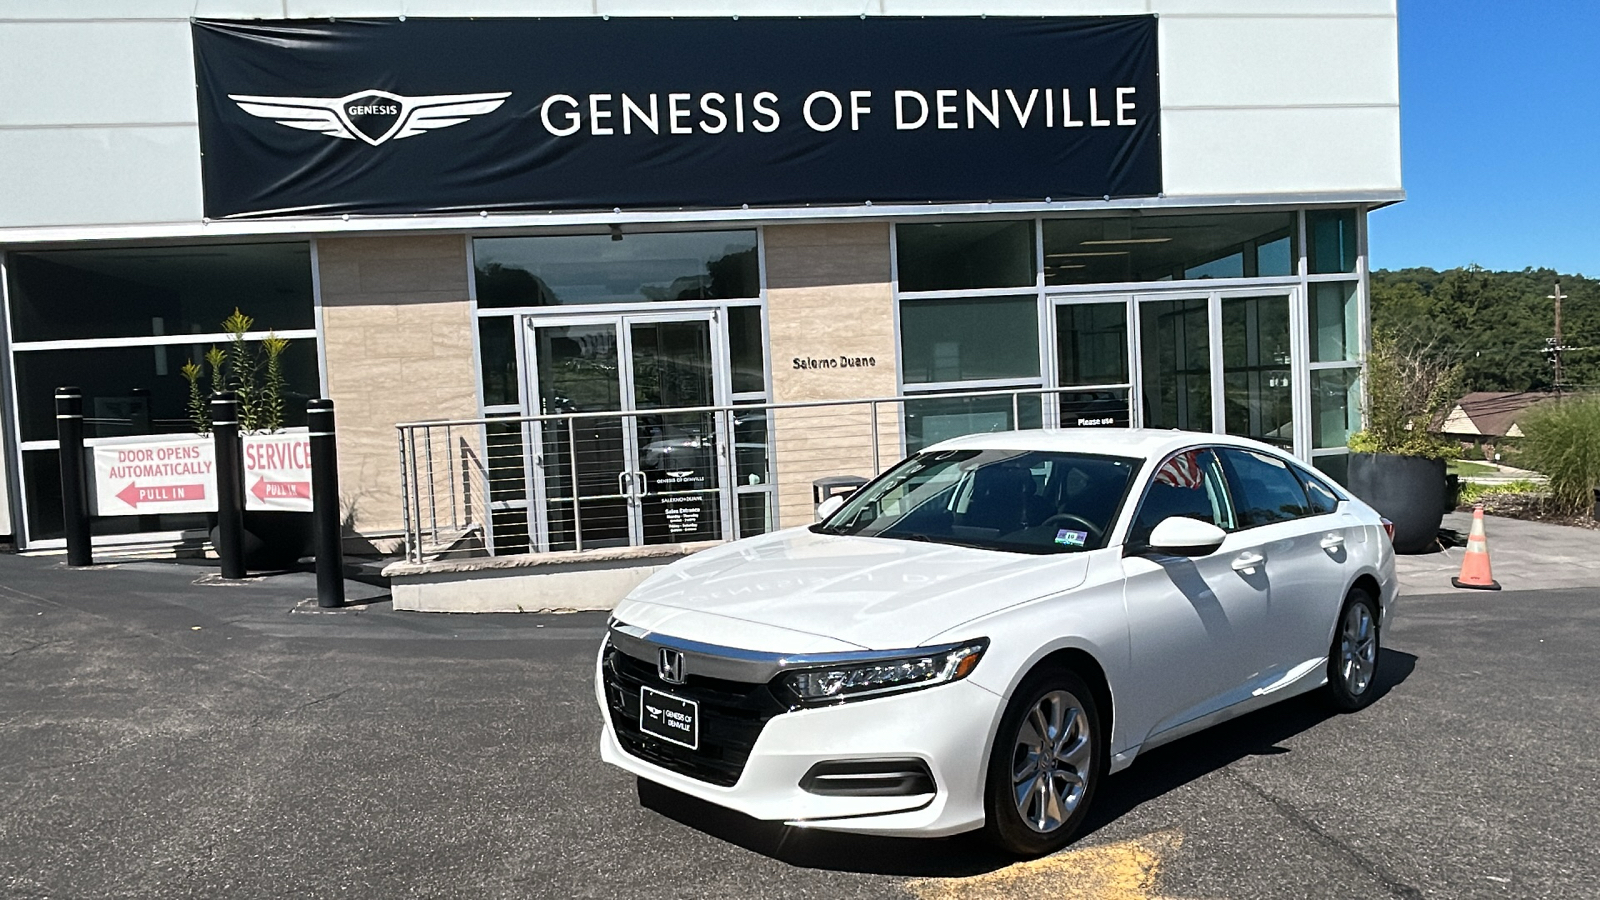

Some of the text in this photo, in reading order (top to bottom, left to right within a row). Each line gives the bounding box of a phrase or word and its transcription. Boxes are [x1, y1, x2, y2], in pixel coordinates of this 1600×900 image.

[348, 105, 398, 116] GENESIS
[540, 87, 1137, 137] GENESIS OF DENVILLE
[792, 355, 876, 370] Salerno Duane
[1077, 417, 1114, 427] Please use
[118, 446, 200, 463] DOOR OPENS
[246, 441, 311, 471] SERVICE
[109, 460, 213, 479] AUTOMATICALLY
[139, 487, 185, 500] PULL IN
[266, 484, 286, 496] PULL
